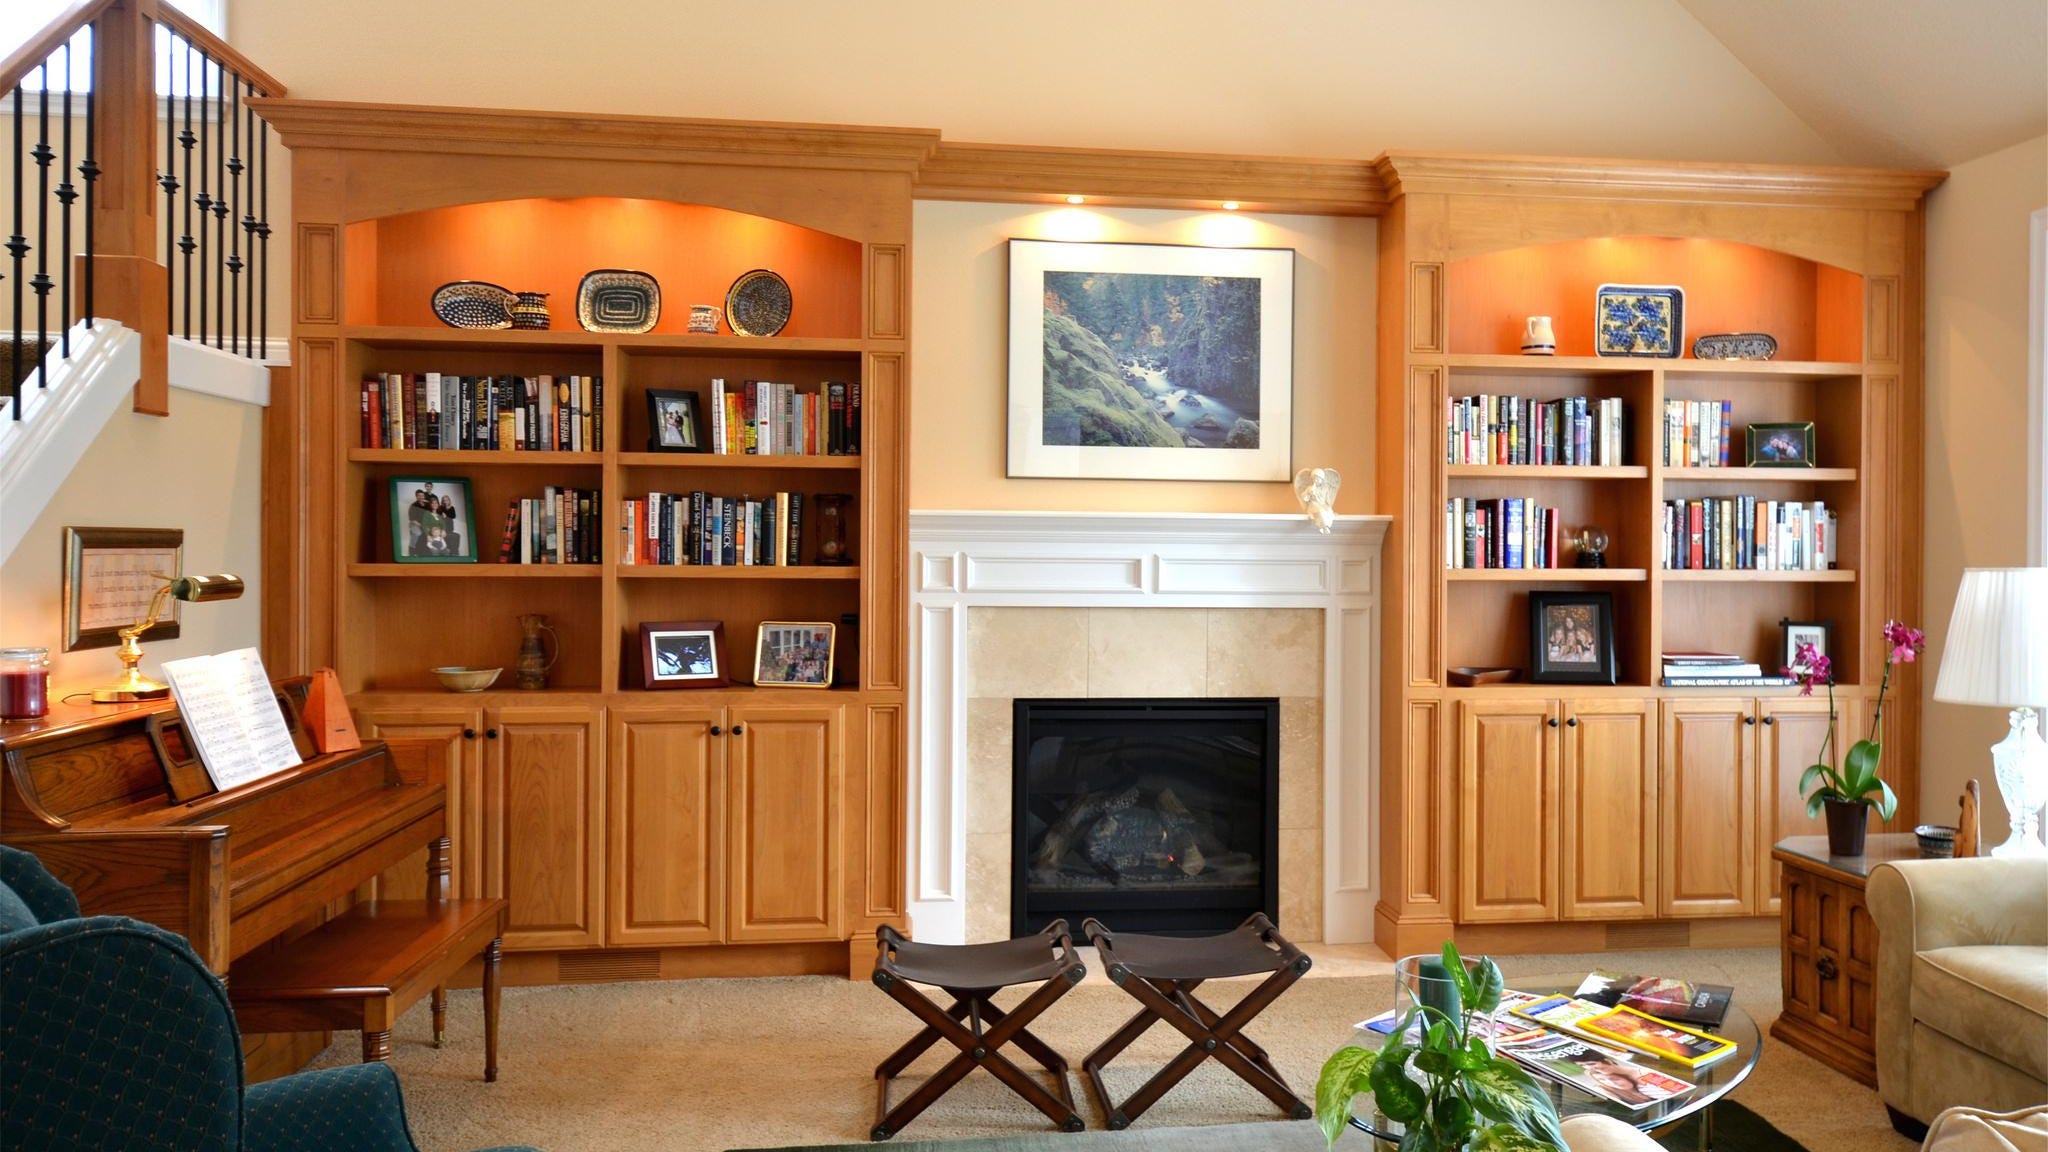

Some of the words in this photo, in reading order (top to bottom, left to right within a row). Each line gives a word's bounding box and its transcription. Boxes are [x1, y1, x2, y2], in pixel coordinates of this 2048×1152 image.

[476, 379, 488, 399] Nelson
[559, 408, 569, 420] JOHN
[559, 421, 569, 443] GRISHAM
[723, 503, 732, 549] STEINBECK
